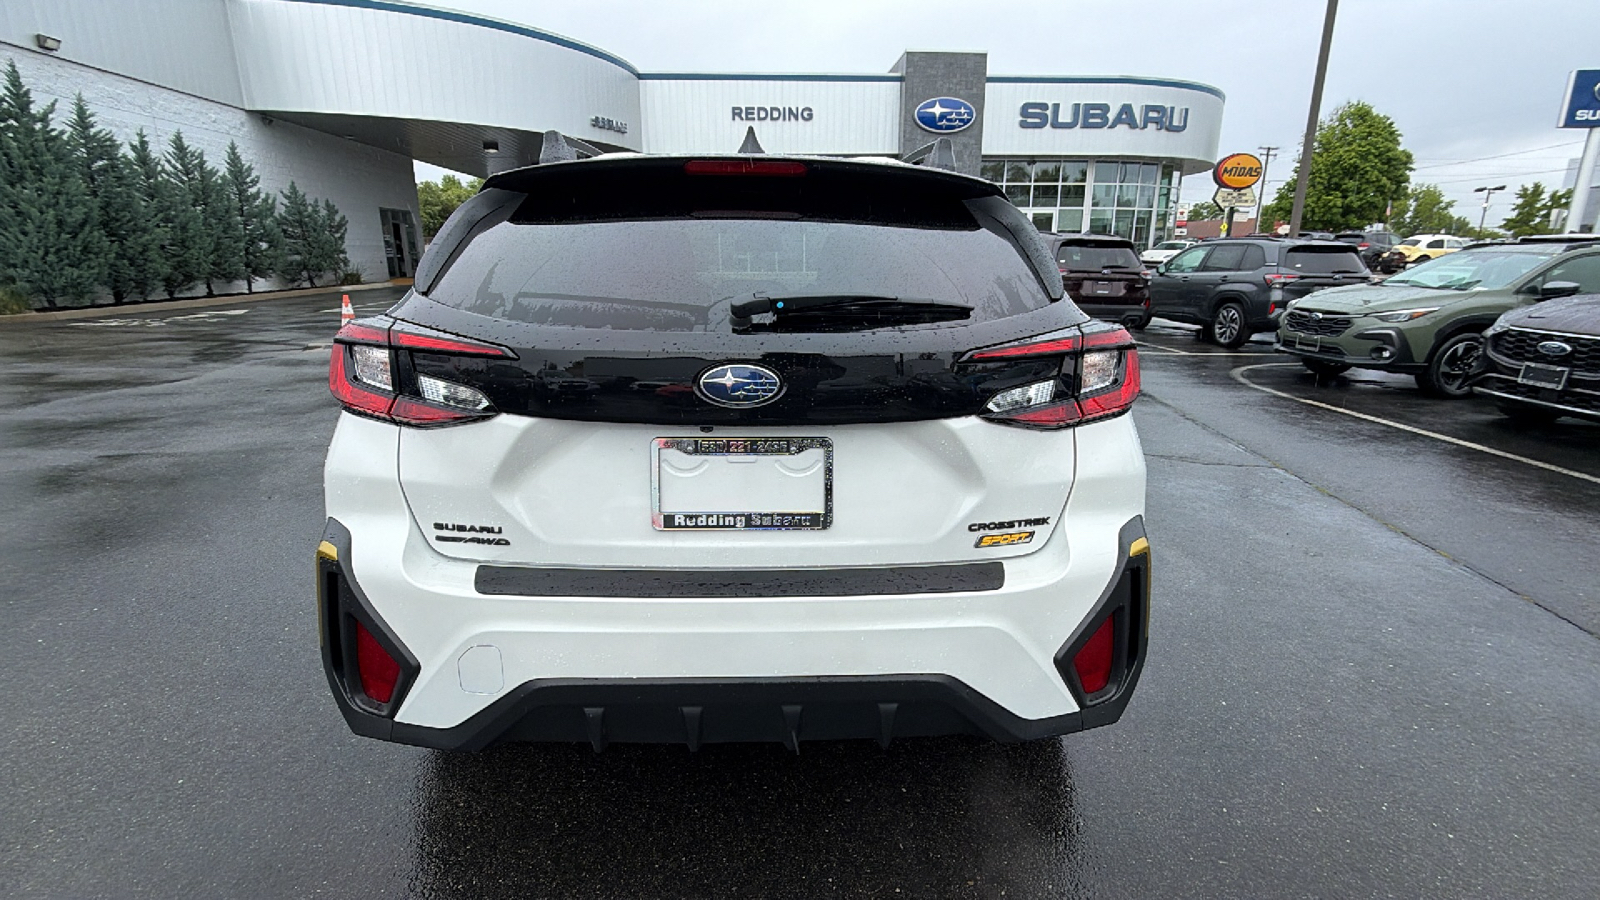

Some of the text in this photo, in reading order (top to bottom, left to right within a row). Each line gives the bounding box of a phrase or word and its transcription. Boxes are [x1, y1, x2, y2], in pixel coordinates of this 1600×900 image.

[731, 106, 814, 121] REDDING
[1019, 102, 1189, 133] SUBARU
[1222, 166, 1262, 178] MIDAS
[433, 522, 503, 534] SUBARU
[674, 514, 811, 528] Redding Subaru
[968, 516, 1051, 532] CROSSTREK
[463, 536, 511, 546] AWD
[980, 532, 1031, 546] SPORT
